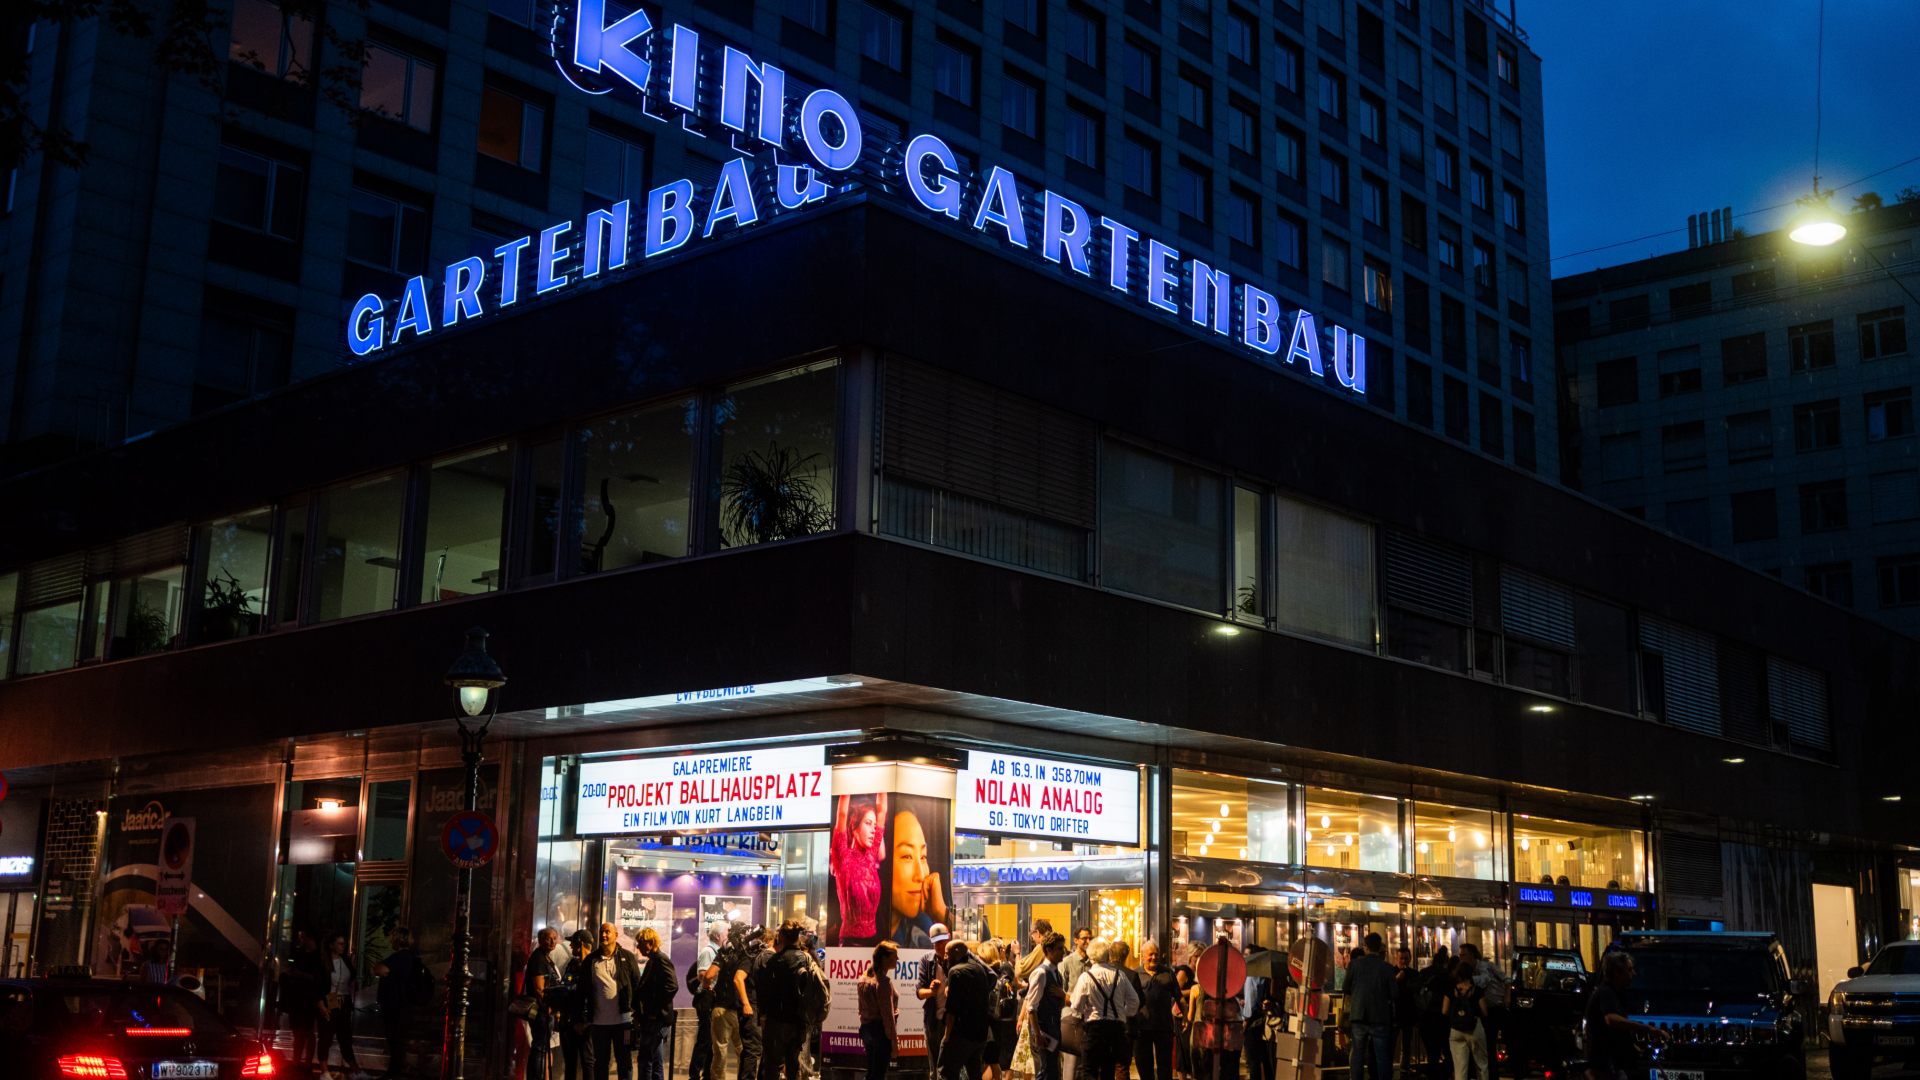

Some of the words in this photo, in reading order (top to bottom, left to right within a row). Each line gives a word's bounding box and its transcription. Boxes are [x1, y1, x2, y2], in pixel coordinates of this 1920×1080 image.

[574, 0, 863, 171] KINO
[904, 133, 1366, 395] GARTENBAU
[346, 157, 828, 357] GARTENBAU
[673, 756, 753, 777] GALAPREMIERE
[990, 759, 1005, 775] AB
[1011, 762, 1033, 779] 16.9.
[1035, 765, 1046, 781] IN
[582, 782, 607, 799] 20:00
[607, 782, 674, 809] PROJEKT
[679, 771, 822, 805] BALLHAUSPLATZ
[976, 778, 1031, 808] NOLAN
[1040, 786, 1103, 815] ANALOG
[623, 812, 640, 827] EIN
[644, 810, 667, 826] FILM
[671, 809, 690, 825] VON
[696, 808, 722, 824] KURT
[727, 805, 783, 823] LANGBEIN
[989, 811, 1008, 826] SO:
[1013, 813, 1045, 830] TOKYO
[1050, 816, 1089, 834] DRIFTER
[998, 866, 1070, 882] EINGANG
[1519, 887, 1554, 903] EINGANG
[1570, 890, 1592, 907] KINO
[1608, 894, 1638, 907] EINGANG
[160, 1065, 168, 1077] W
[176, 1065, 201, 1077] 9023
[204, 1065, 216, 1077] TX
